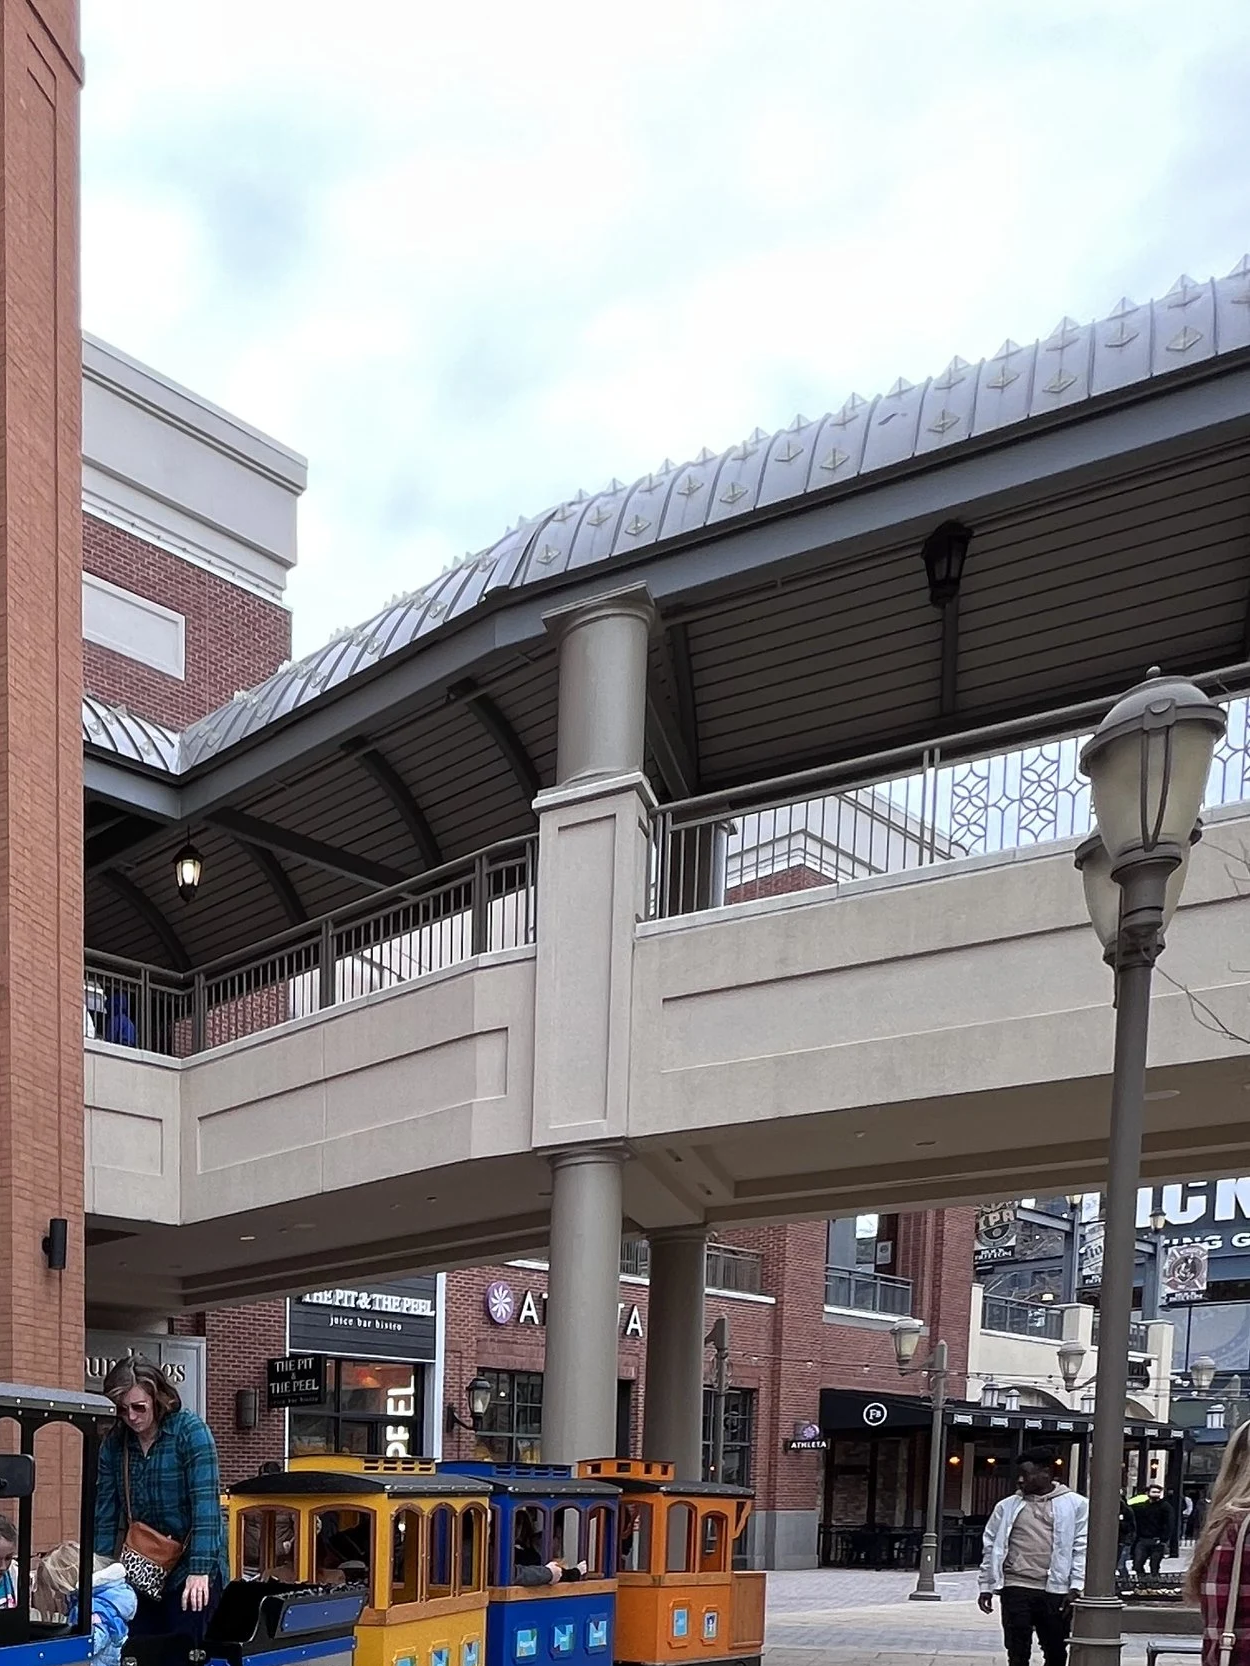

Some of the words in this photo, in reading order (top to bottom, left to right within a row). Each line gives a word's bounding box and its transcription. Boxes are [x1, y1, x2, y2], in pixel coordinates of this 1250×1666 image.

[335, 1289, 358, 1309] PIT
[356, 1292, 372, 1310] &
[371, 1293, 401, 1313] THE
[400, 1298, 436, 1317] PEEL
[329, 1314, 353, 1327] juice
[356, 1316, 371, 1328] bar
[375, 1319, 402, 1331] bistro
[274, 1359, 295, 1372] THE
[297, 1357, 314, 1371] PIT
[291, 1372, 297, 1380] &
[269, 1381, 291, 1395] THE
[293, 1379, 319, 1392] PEEL
[791, 1440, 827, 1449] ATHLETA
